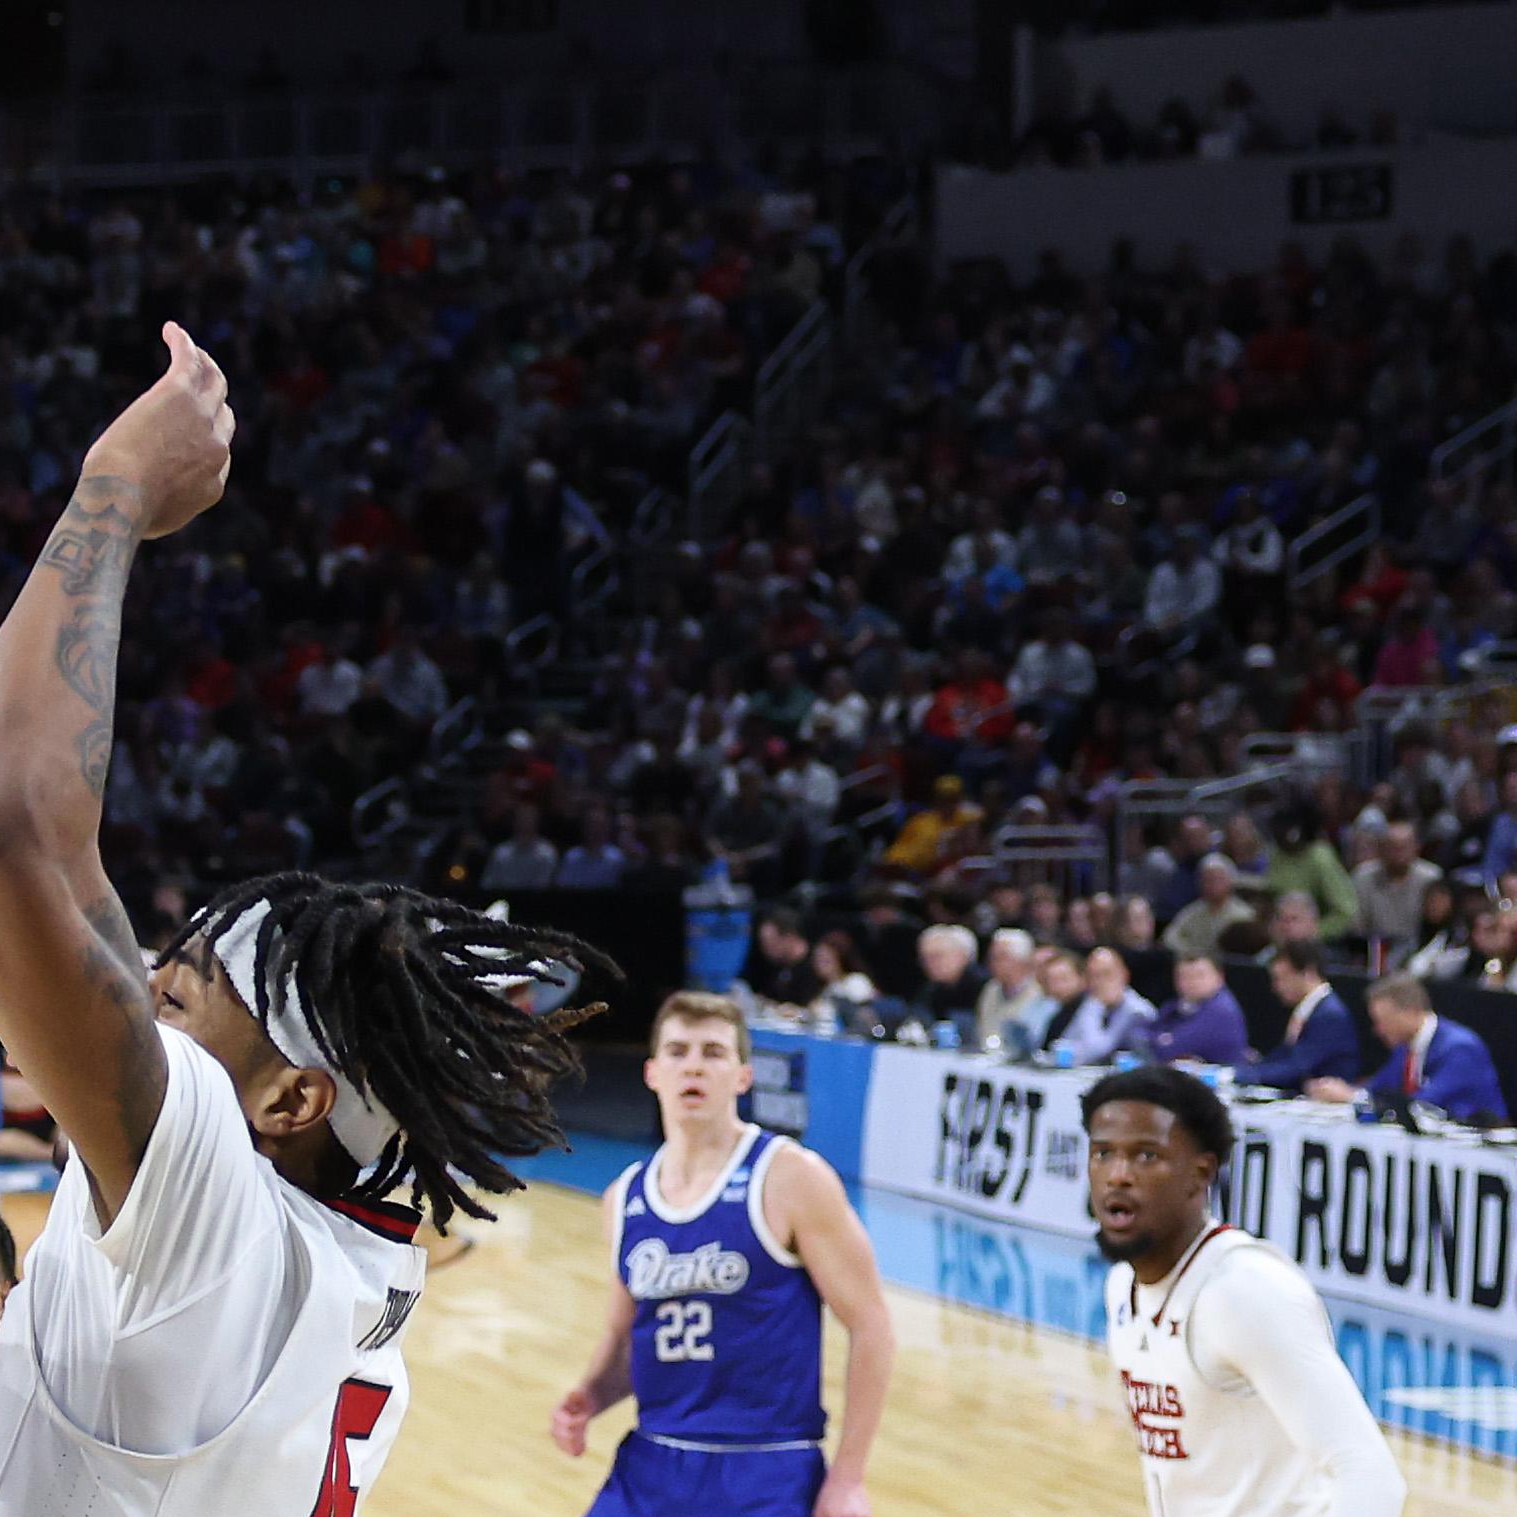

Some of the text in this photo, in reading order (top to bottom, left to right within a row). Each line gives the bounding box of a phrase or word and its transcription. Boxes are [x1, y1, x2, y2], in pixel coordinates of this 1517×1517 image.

[934, 1072, 1045, 1206] FIRST
[625, 1237, 751, 1300] Drake
[1295, 1140, 1510, 1310] ROUND
[654, 1300, 715, 1363] 22
